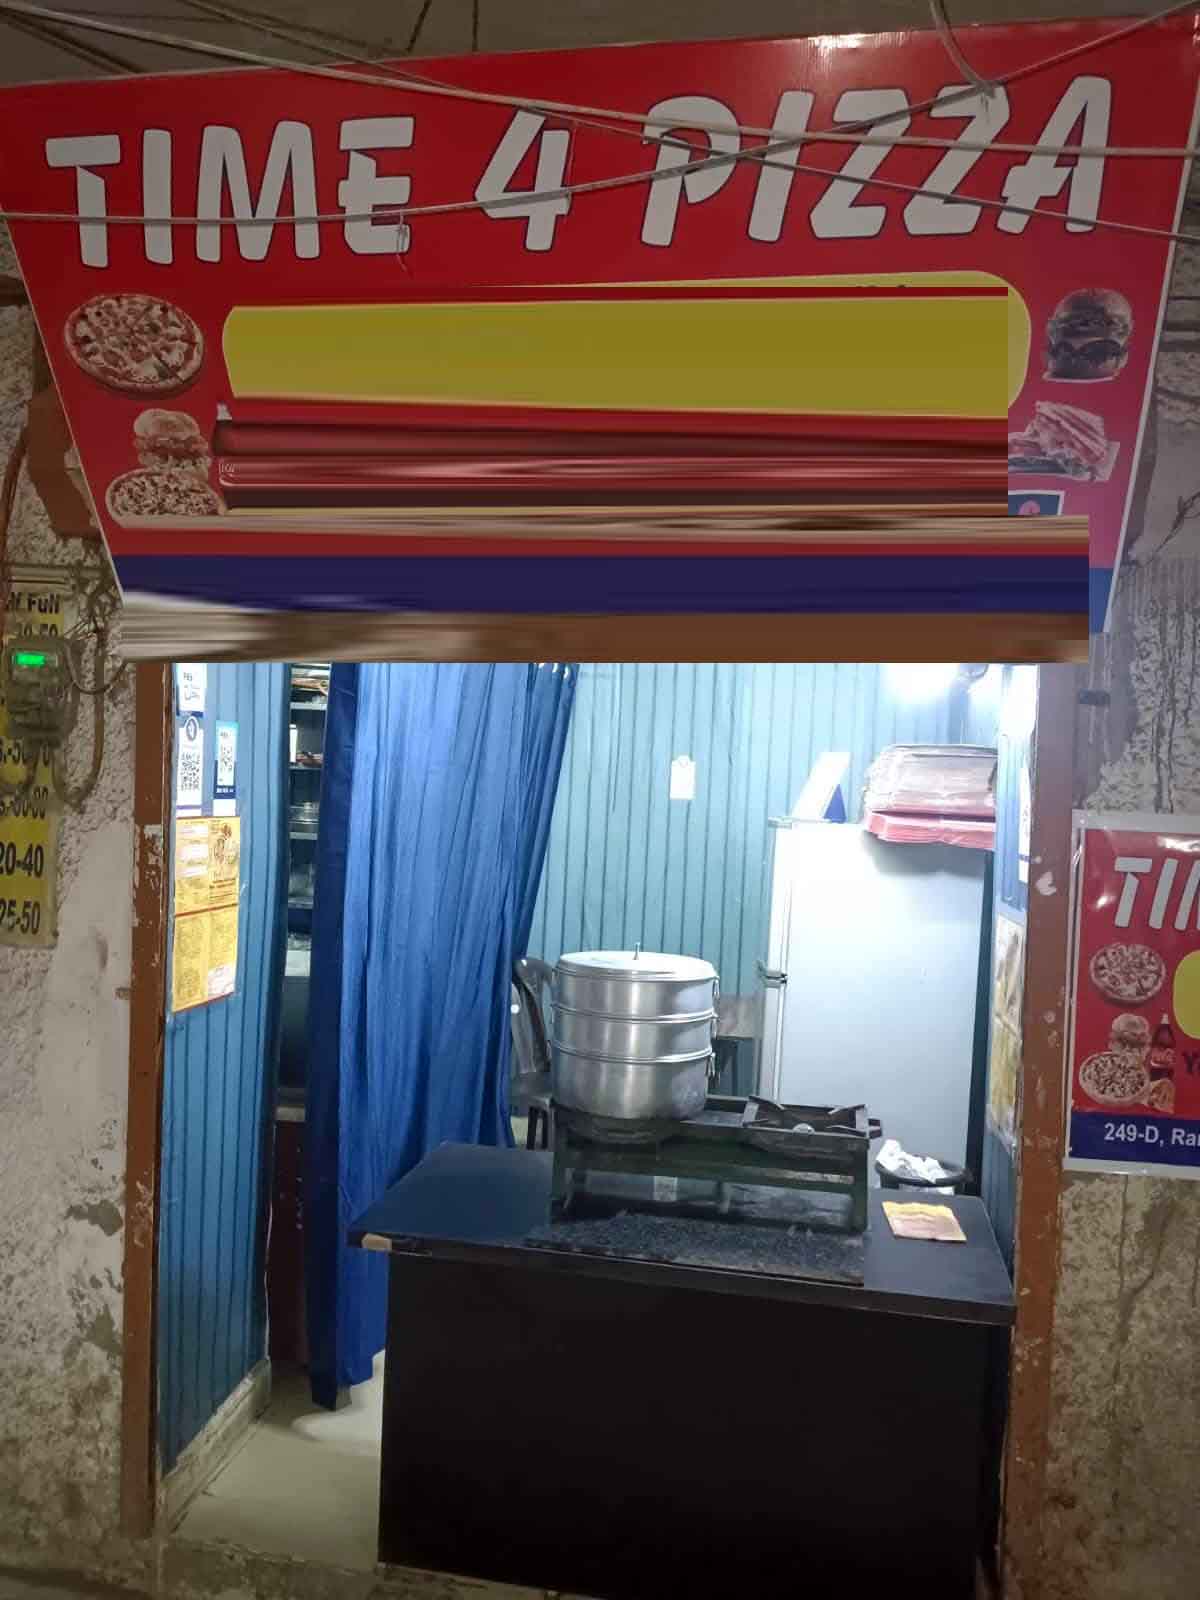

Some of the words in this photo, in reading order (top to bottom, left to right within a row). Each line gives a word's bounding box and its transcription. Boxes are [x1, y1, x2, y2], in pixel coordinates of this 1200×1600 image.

[45, 115, 416, 268] TIME
[474, 109, 572, 252] 4
[640, 75, 1112, 247] PIZZA
[1104, 1122, 1164, 1147] 249-D,
